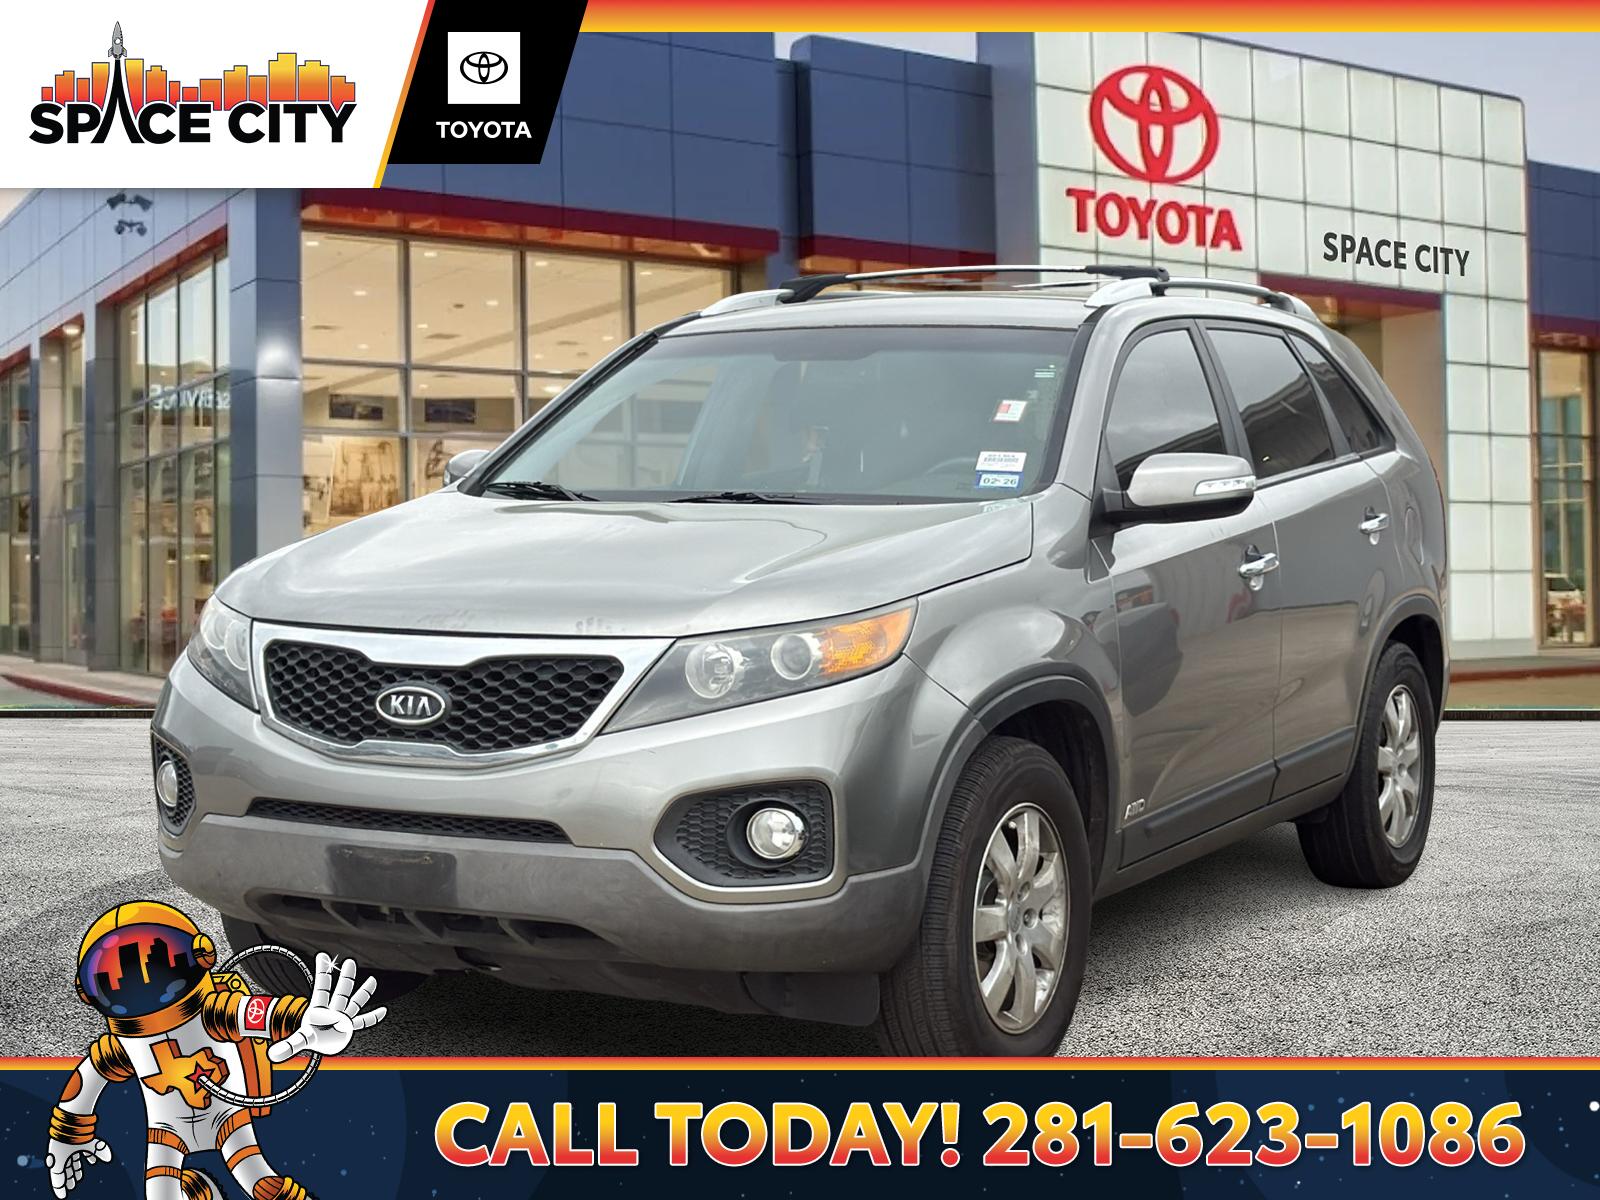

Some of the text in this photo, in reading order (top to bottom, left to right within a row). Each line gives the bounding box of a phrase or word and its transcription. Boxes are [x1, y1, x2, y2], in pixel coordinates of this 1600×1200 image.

[1066, 187, 1242, 252] TOYOTA
[1322, 231, 1471, 277] SPACE CITY
[389, 693, 432, 717] KIA
